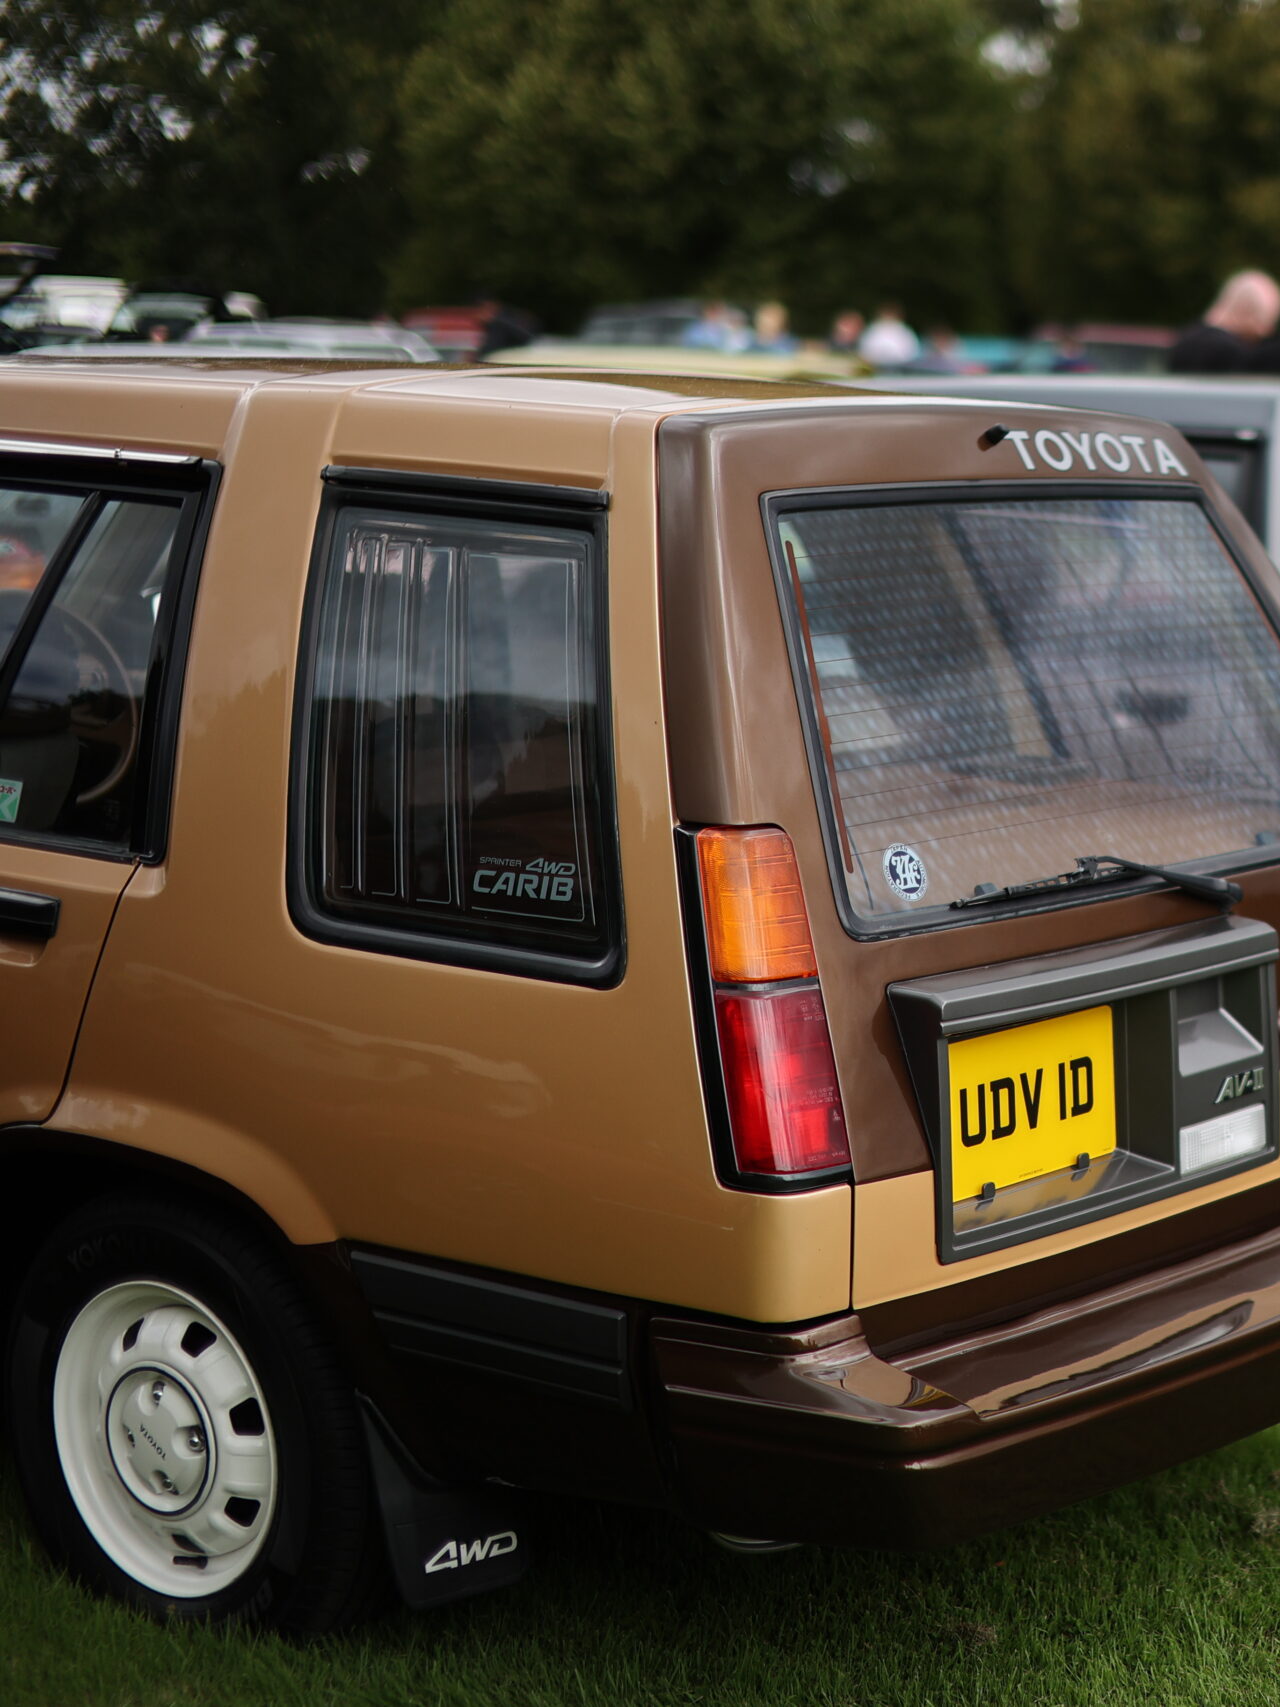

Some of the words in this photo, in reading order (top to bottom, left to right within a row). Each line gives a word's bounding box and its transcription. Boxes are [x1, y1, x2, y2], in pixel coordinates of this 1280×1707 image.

[1004, 429, 1189, 477] TOYOTA
[473, 869, 574, 902] CARIB
[479, 856, 522, 867] SPRINTER
[525, 857, 576, 876] 4WD
[959, 1067, 1044, 1148] UDV
[140, 1423, 166, 1461] TOYOTA
[425, 1531, 518, 1574] 4WD
